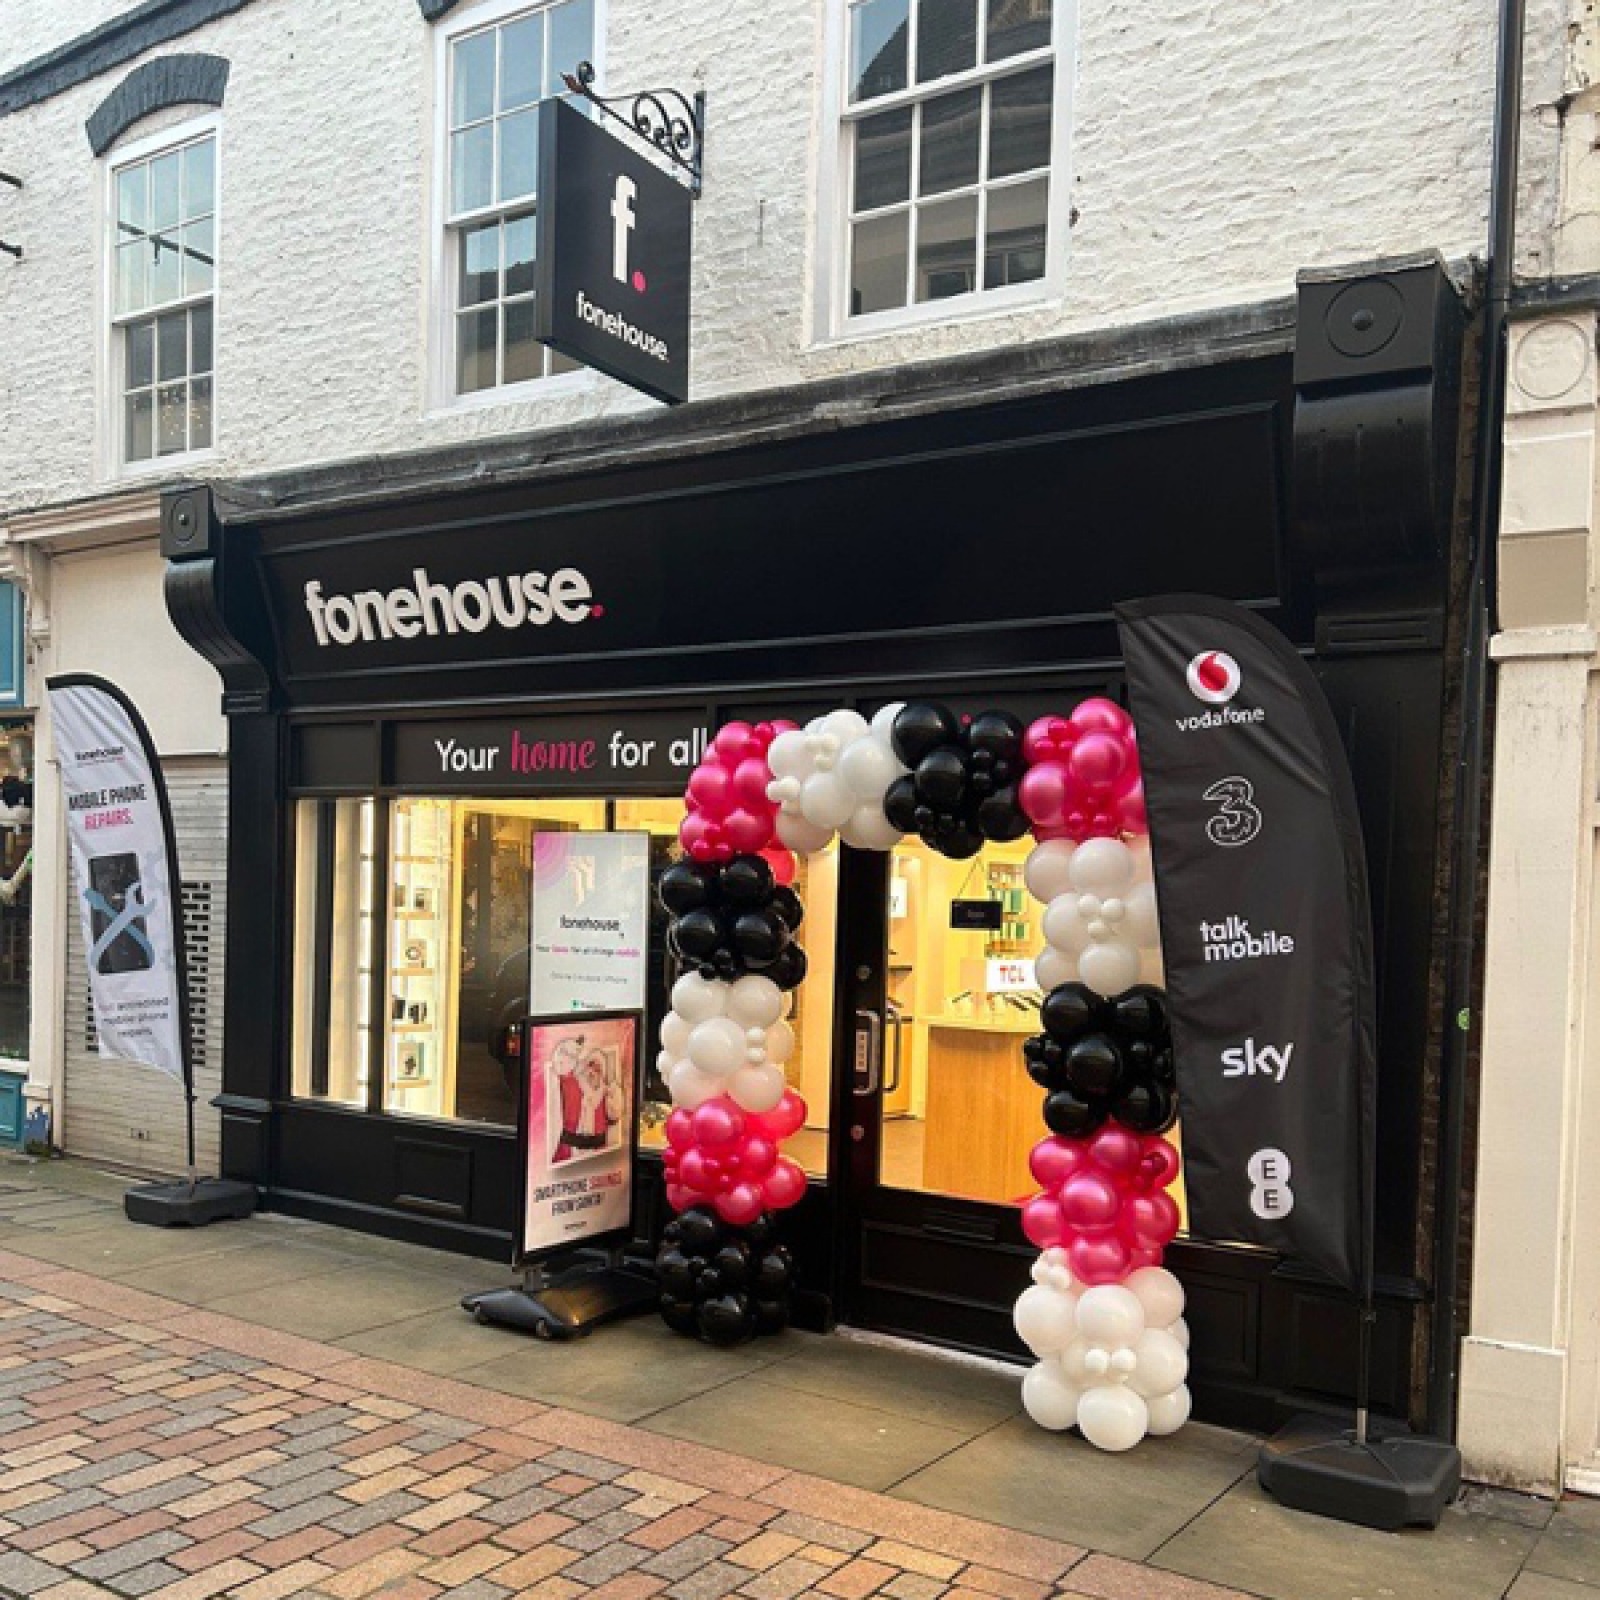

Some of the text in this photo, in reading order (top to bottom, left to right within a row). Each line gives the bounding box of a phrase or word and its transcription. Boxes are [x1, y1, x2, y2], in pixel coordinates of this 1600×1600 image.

[304, 567, 604, 646] fonehouse.
[1176, 706, 1265, 732] vodafone
[434, 738, 499, 772] Your
[511, 729, 598, 774] home
[608, 730, 656, 768] for
[68, 783, 147, 812] MOBILE PHONE
[1203, 776, 1262, 847] 3
[1200, 914, 1251, 942] talk
[1204, 930, 1295, 962] mobile
[999, 964, 1025, 984] TCL
[1220, 1037, 1294, 1083] sky
